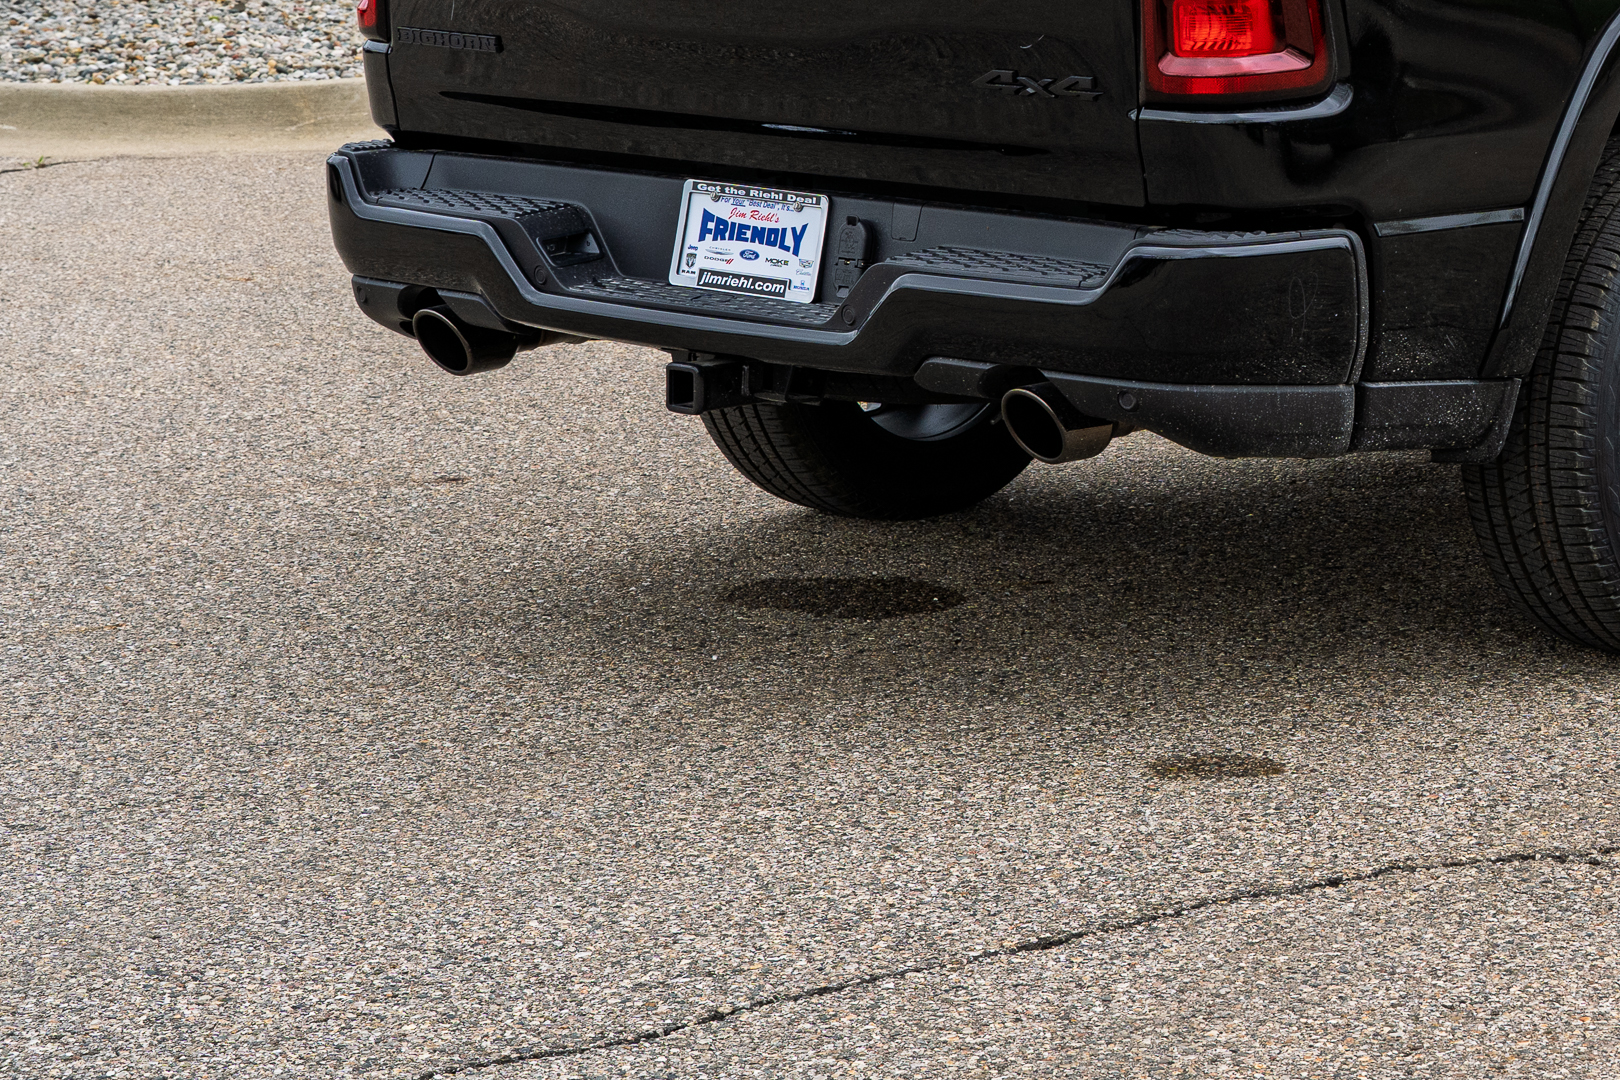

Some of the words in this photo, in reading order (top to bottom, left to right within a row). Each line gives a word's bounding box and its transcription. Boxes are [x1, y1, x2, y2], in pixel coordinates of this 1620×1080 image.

[697, 183, 721, 193] Get
[724, 186, 746, 196] the
[749, 189, 783, 201] Riehl
[787, 193, 817, 205] Deal
[731, 197, 746, 207] Your
[728, 207, 747, 220] Jim
[748, 209, 780, 224] Riehl's
[697, 208, 809, 258] FRIENDLY
[699, 271, 785, 294] jimriehl.com
